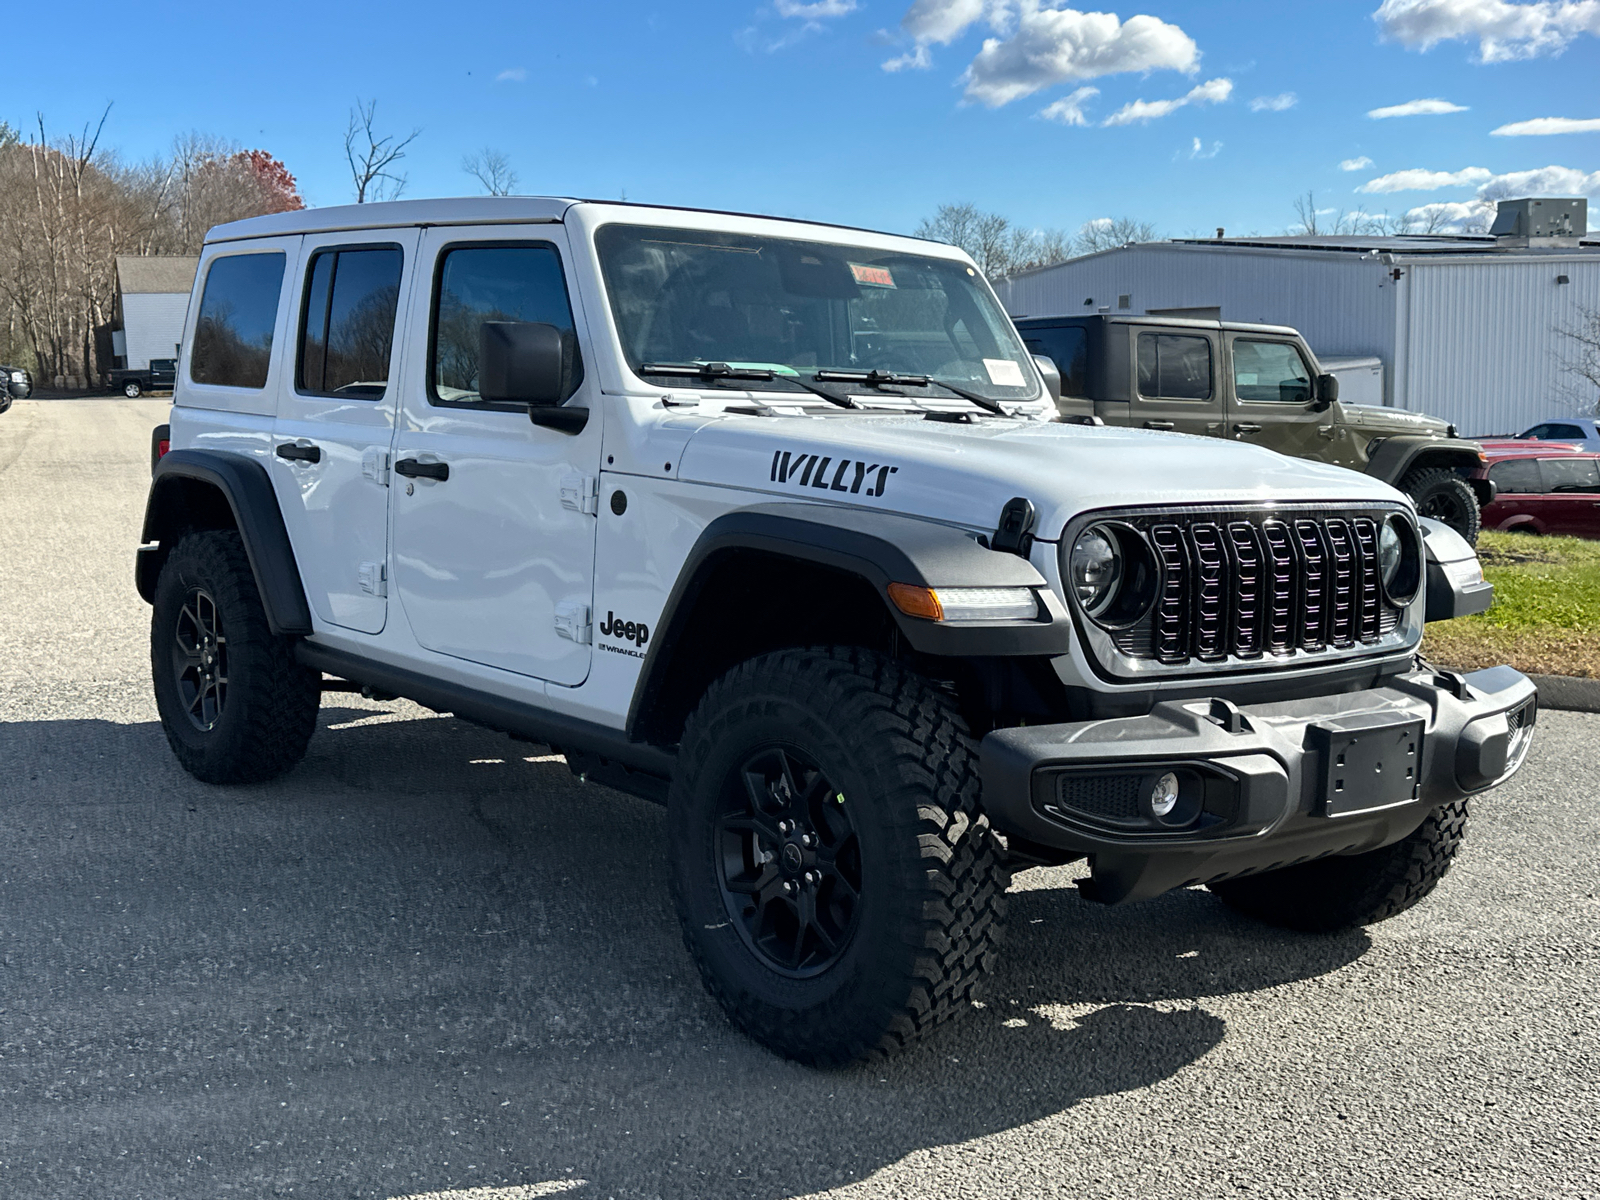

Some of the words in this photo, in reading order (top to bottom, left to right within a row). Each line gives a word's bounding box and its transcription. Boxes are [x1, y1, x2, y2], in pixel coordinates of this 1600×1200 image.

[770, 450, 899, 497] WILLYS
[600, 610, 649, 648] Jeep
[606, 644, 647, 660] WRANGLE
